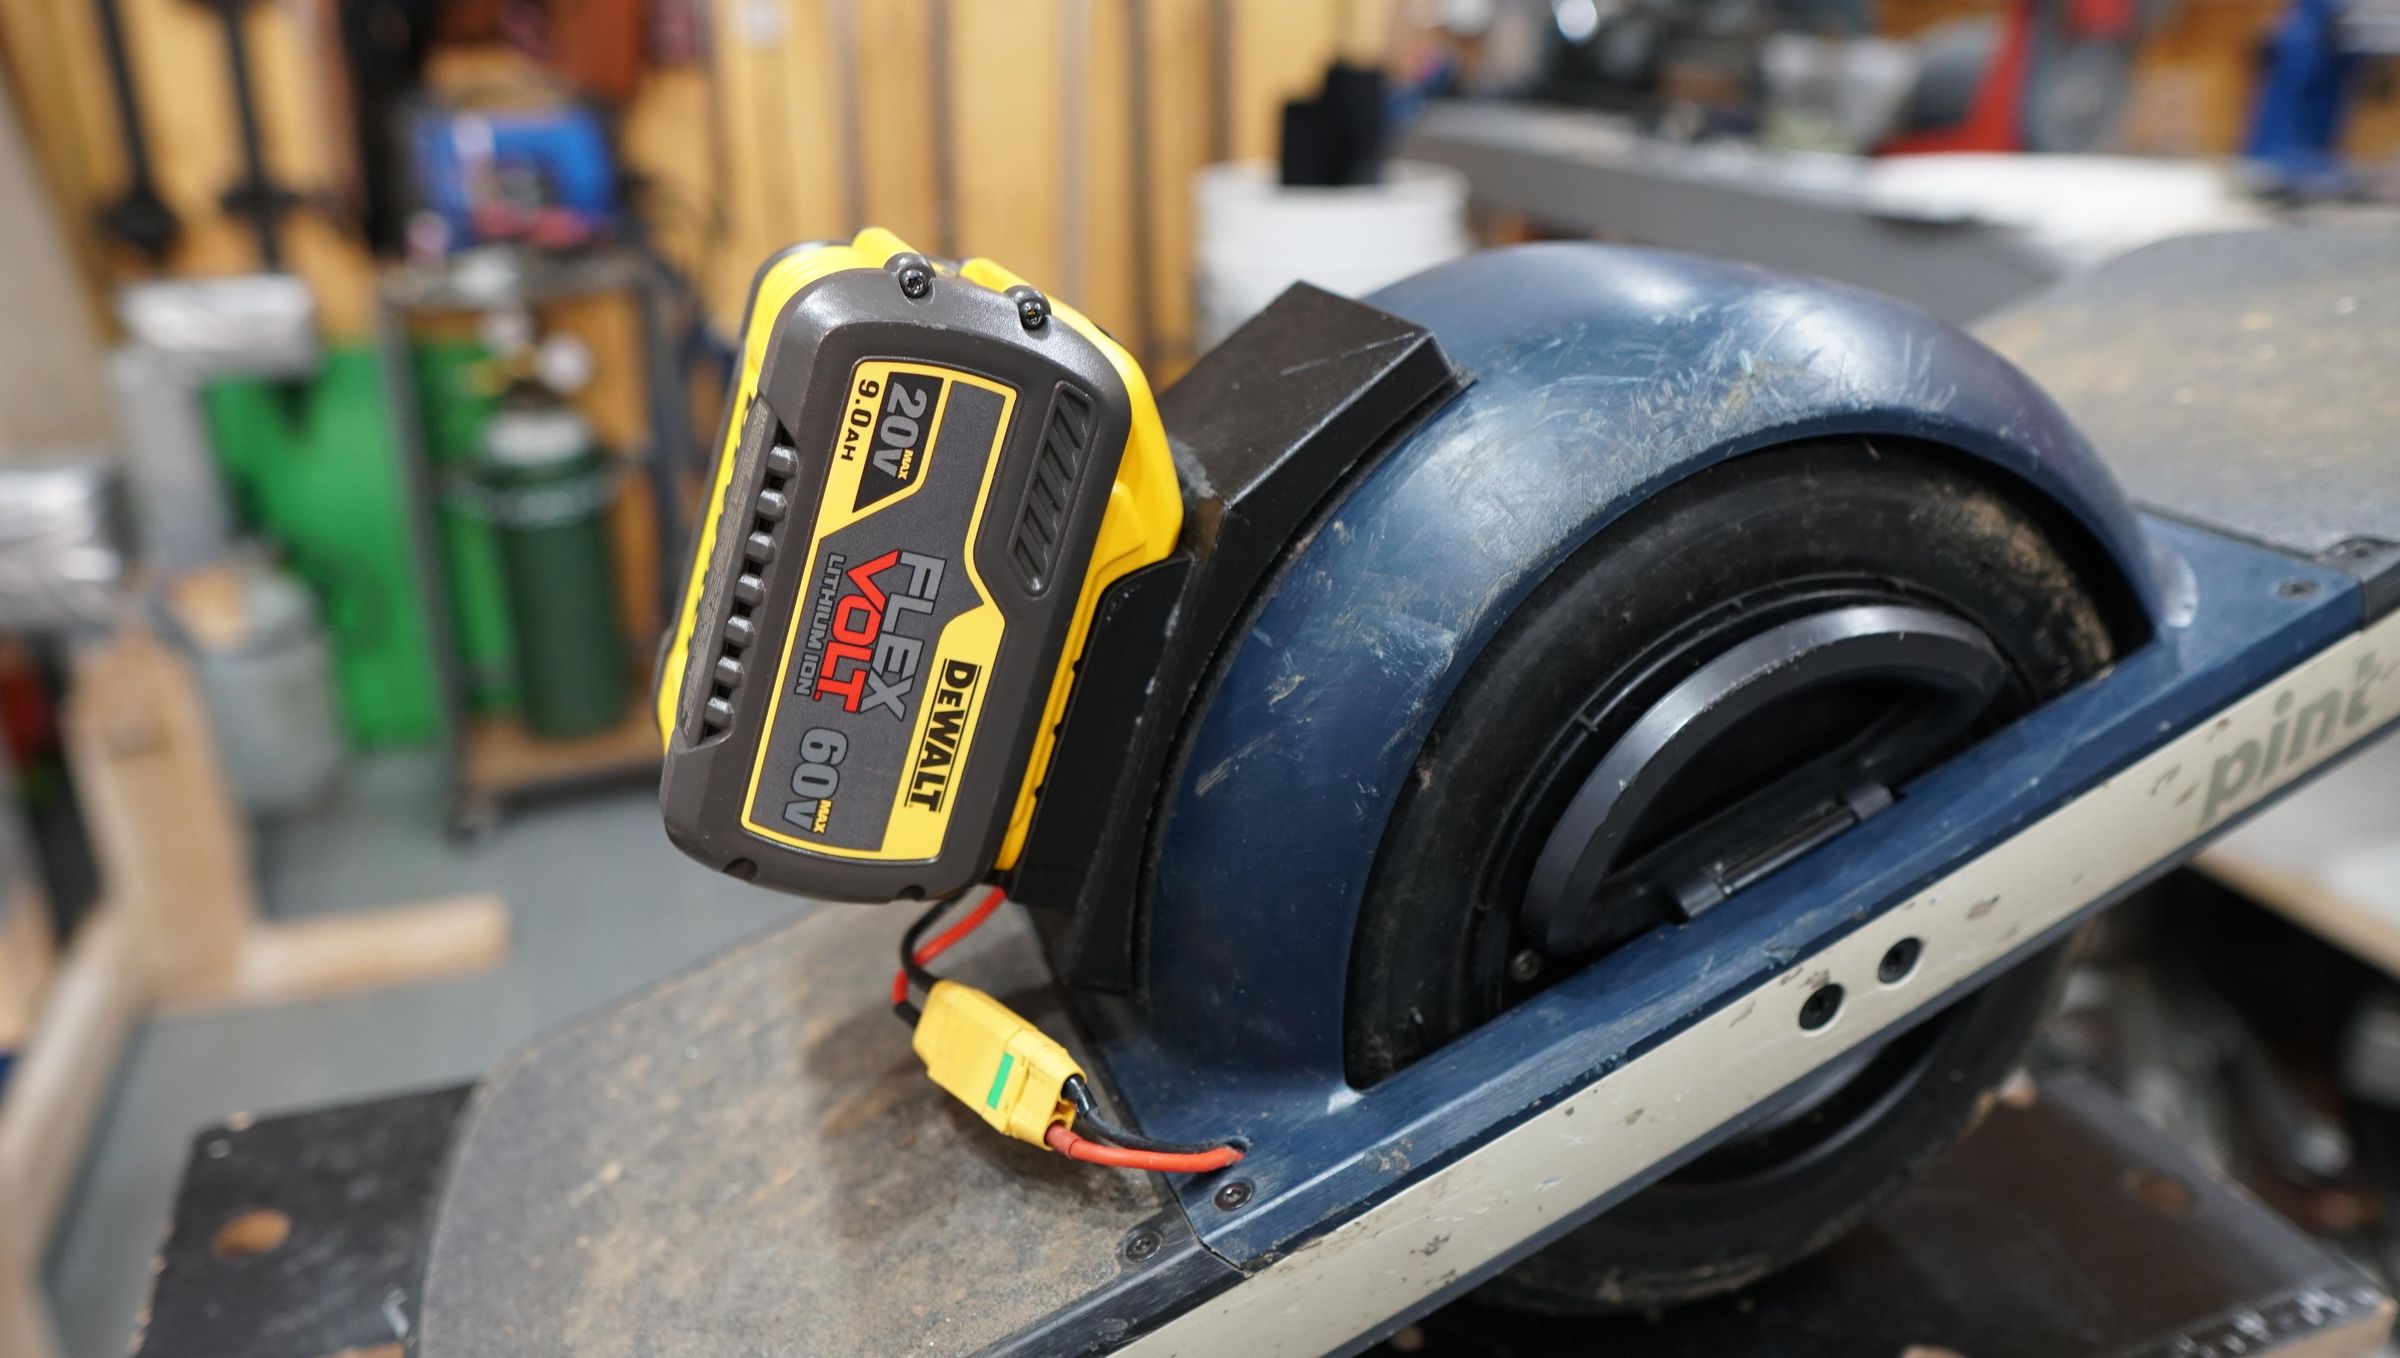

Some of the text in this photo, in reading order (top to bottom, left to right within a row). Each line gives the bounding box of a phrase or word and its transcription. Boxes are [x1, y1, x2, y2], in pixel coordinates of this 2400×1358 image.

[840, 377, 880, 462] 9.0AH
[872, 381, 928, 480] 20V MAX
[794, 552, 847, 697] LITHIUM ION
[817, 548, 901, 714] VOLT
[858, 550, 947, 722] FLEX
[782, 726, 849, 835] 60V MAX
[909, 658, 979, 813] DEWALT
[2201, 652, 2377, 826] pint
